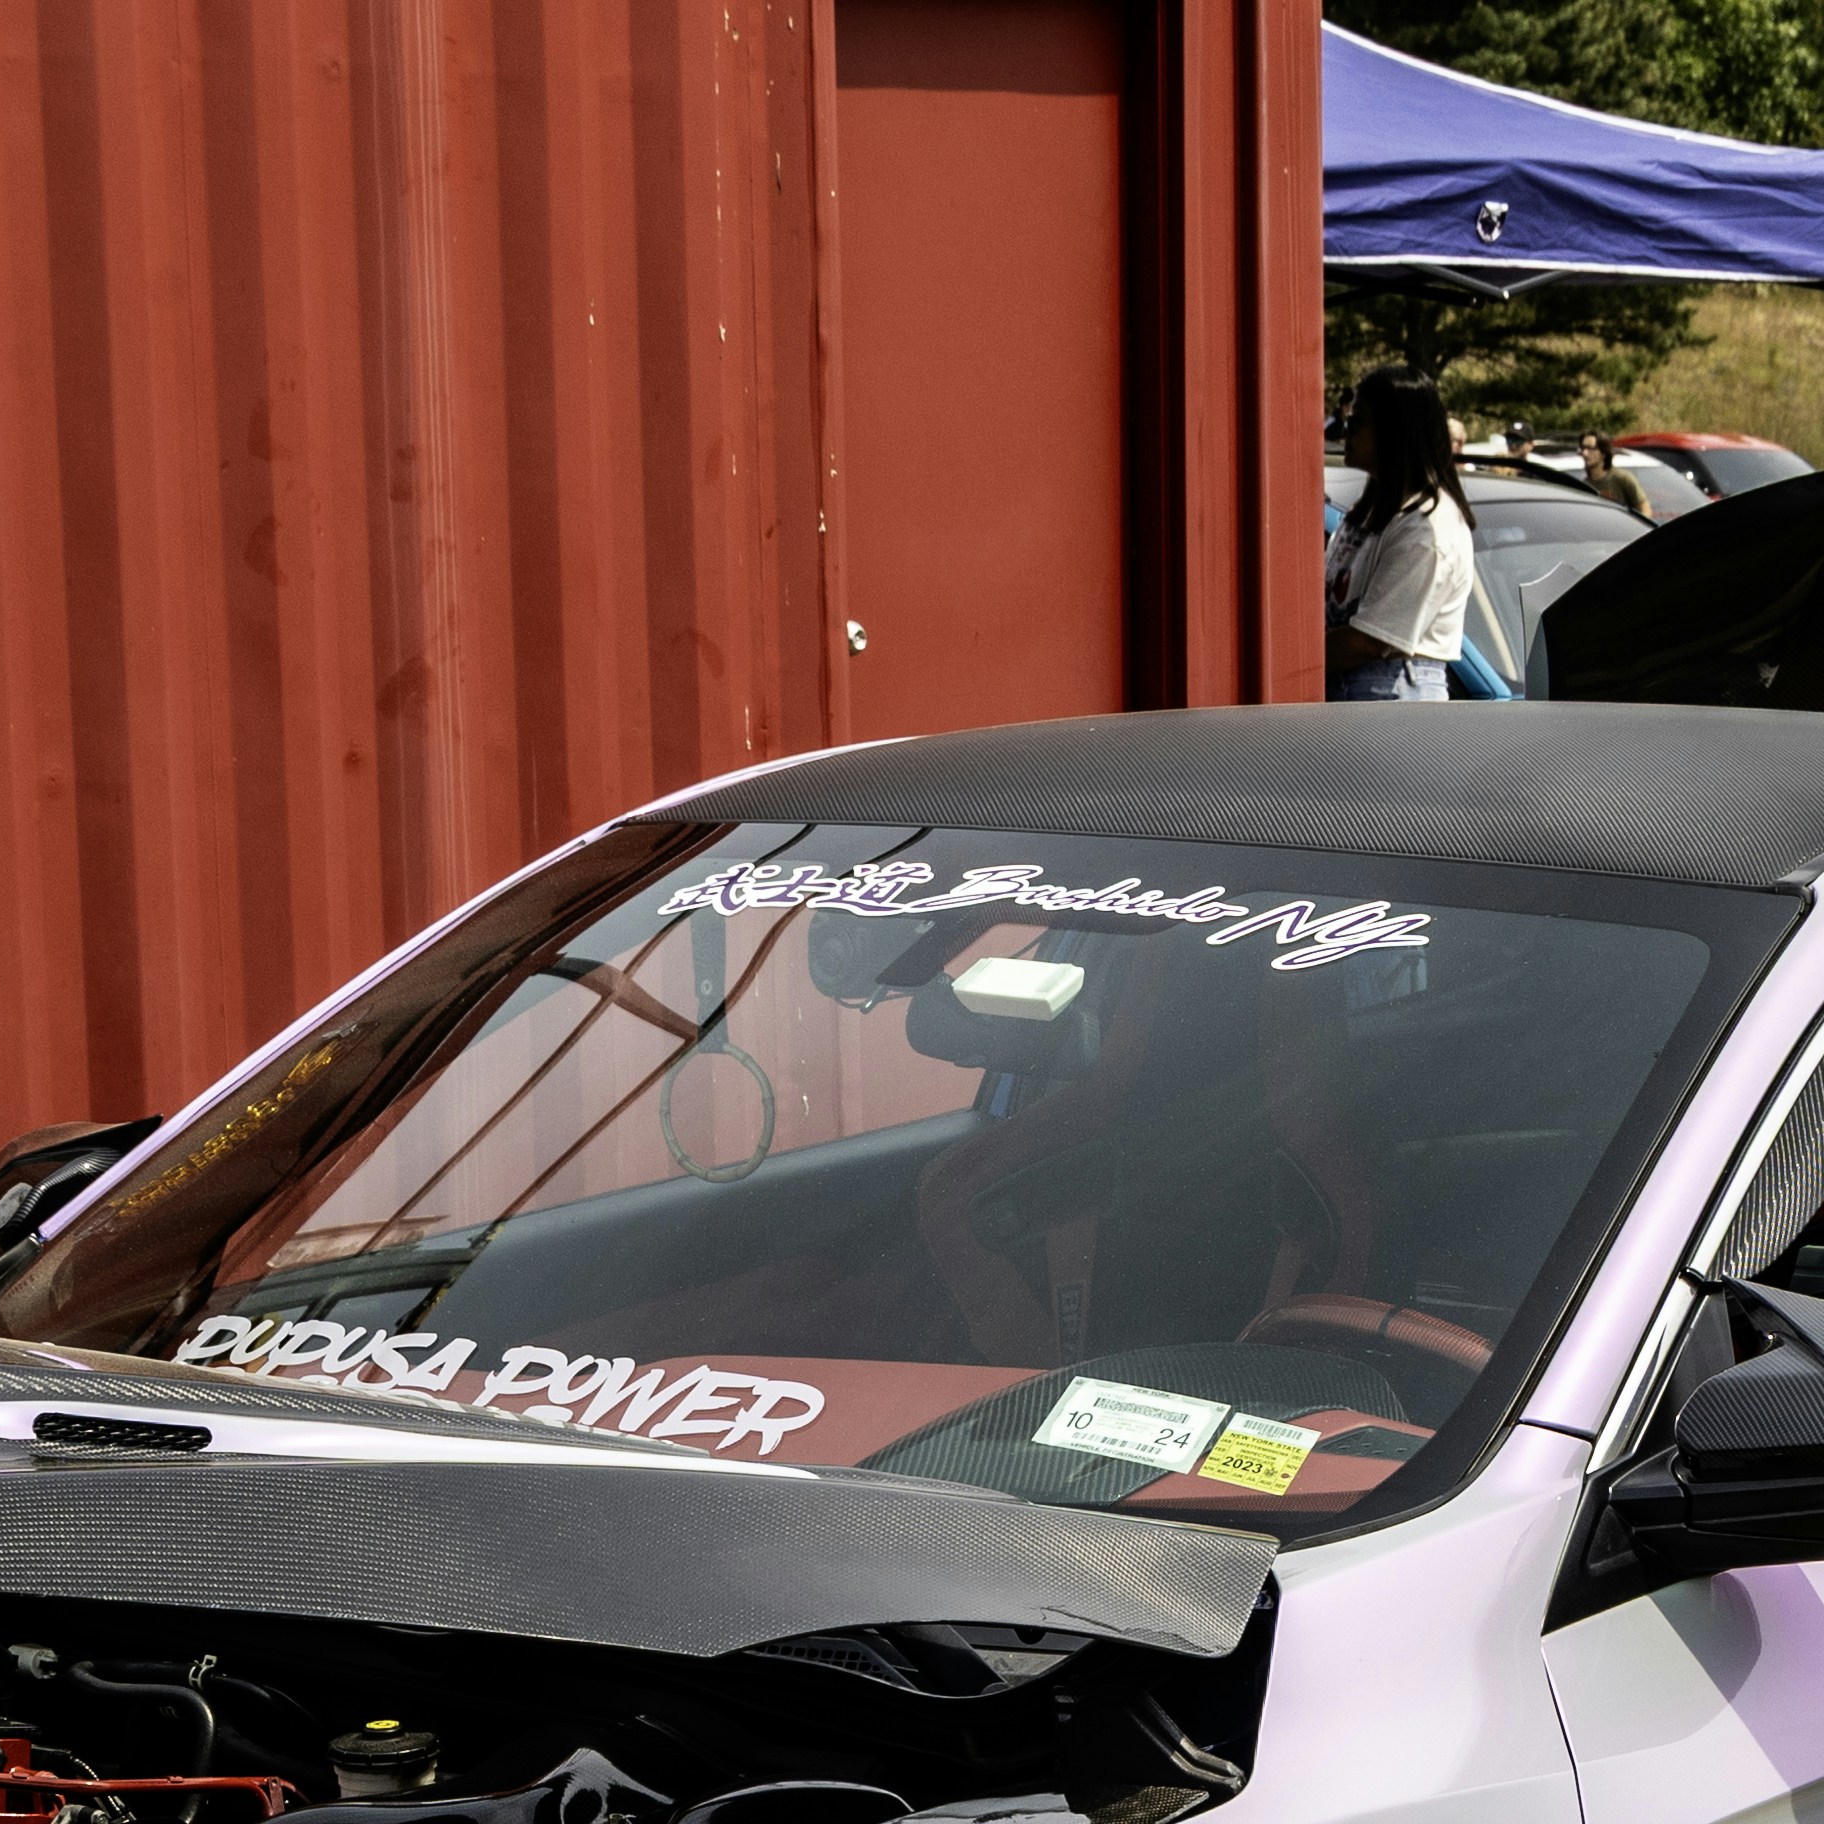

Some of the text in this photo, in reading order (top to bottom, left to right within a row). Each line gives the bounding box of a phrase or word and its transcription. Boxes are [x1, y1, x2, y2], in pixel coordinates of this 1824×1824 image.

[174, 1313, 825, 1456] PUPUSA POWER
[1066, 1410, 1094, 1430] 10
[1154, 1428, 1192, 1449] 24
[1230, 1432, 1248, 1441] NEW
[1251, 1436, 1273, 1446] YORK
[1277, 1443, 1303, 1454] STATE
[1221, 1456, 1263, 1474] 2023
